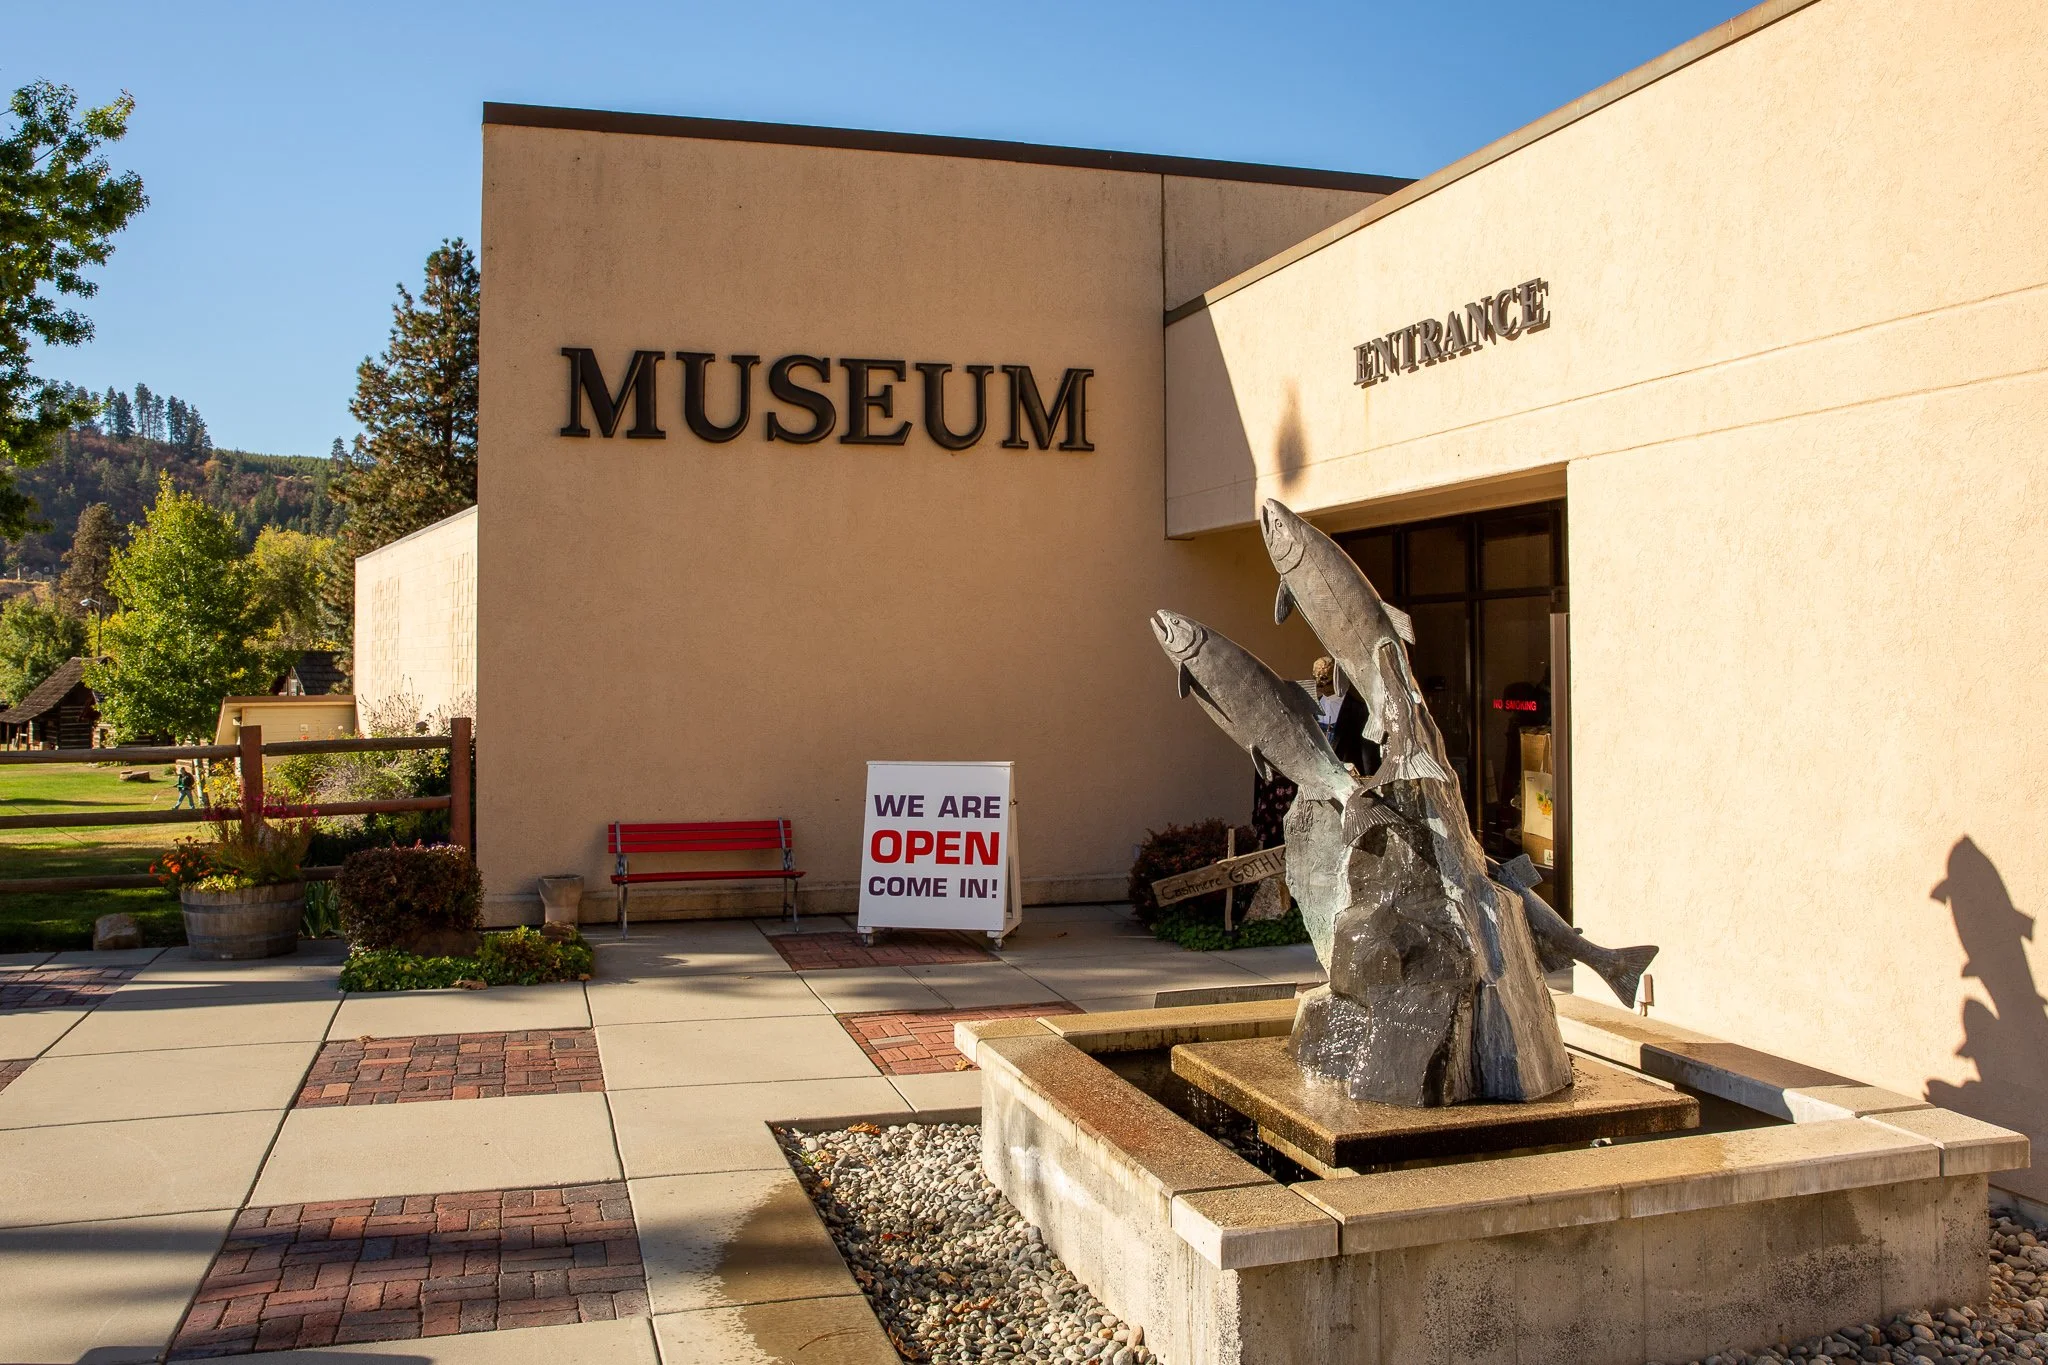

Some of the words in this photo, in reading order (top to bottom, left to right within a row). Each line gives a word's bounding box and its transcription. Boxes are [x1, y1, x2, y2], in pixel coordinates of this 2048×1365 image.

[1353, 277, 1550, 388] ENTRANCE
[560, 347, 1095, 452] MUSEUM
[1493, 699, 1503, 709] NO
[1505, 700, 1537, 711] SMOKING
[874, 794, 925, 818] WE
[937, 795, 1001, 819] ARE
[870, 829, 1000, 866] OPEN
[868, 875, 948, 898] COME
[959, 878, 998, 899] IN!
